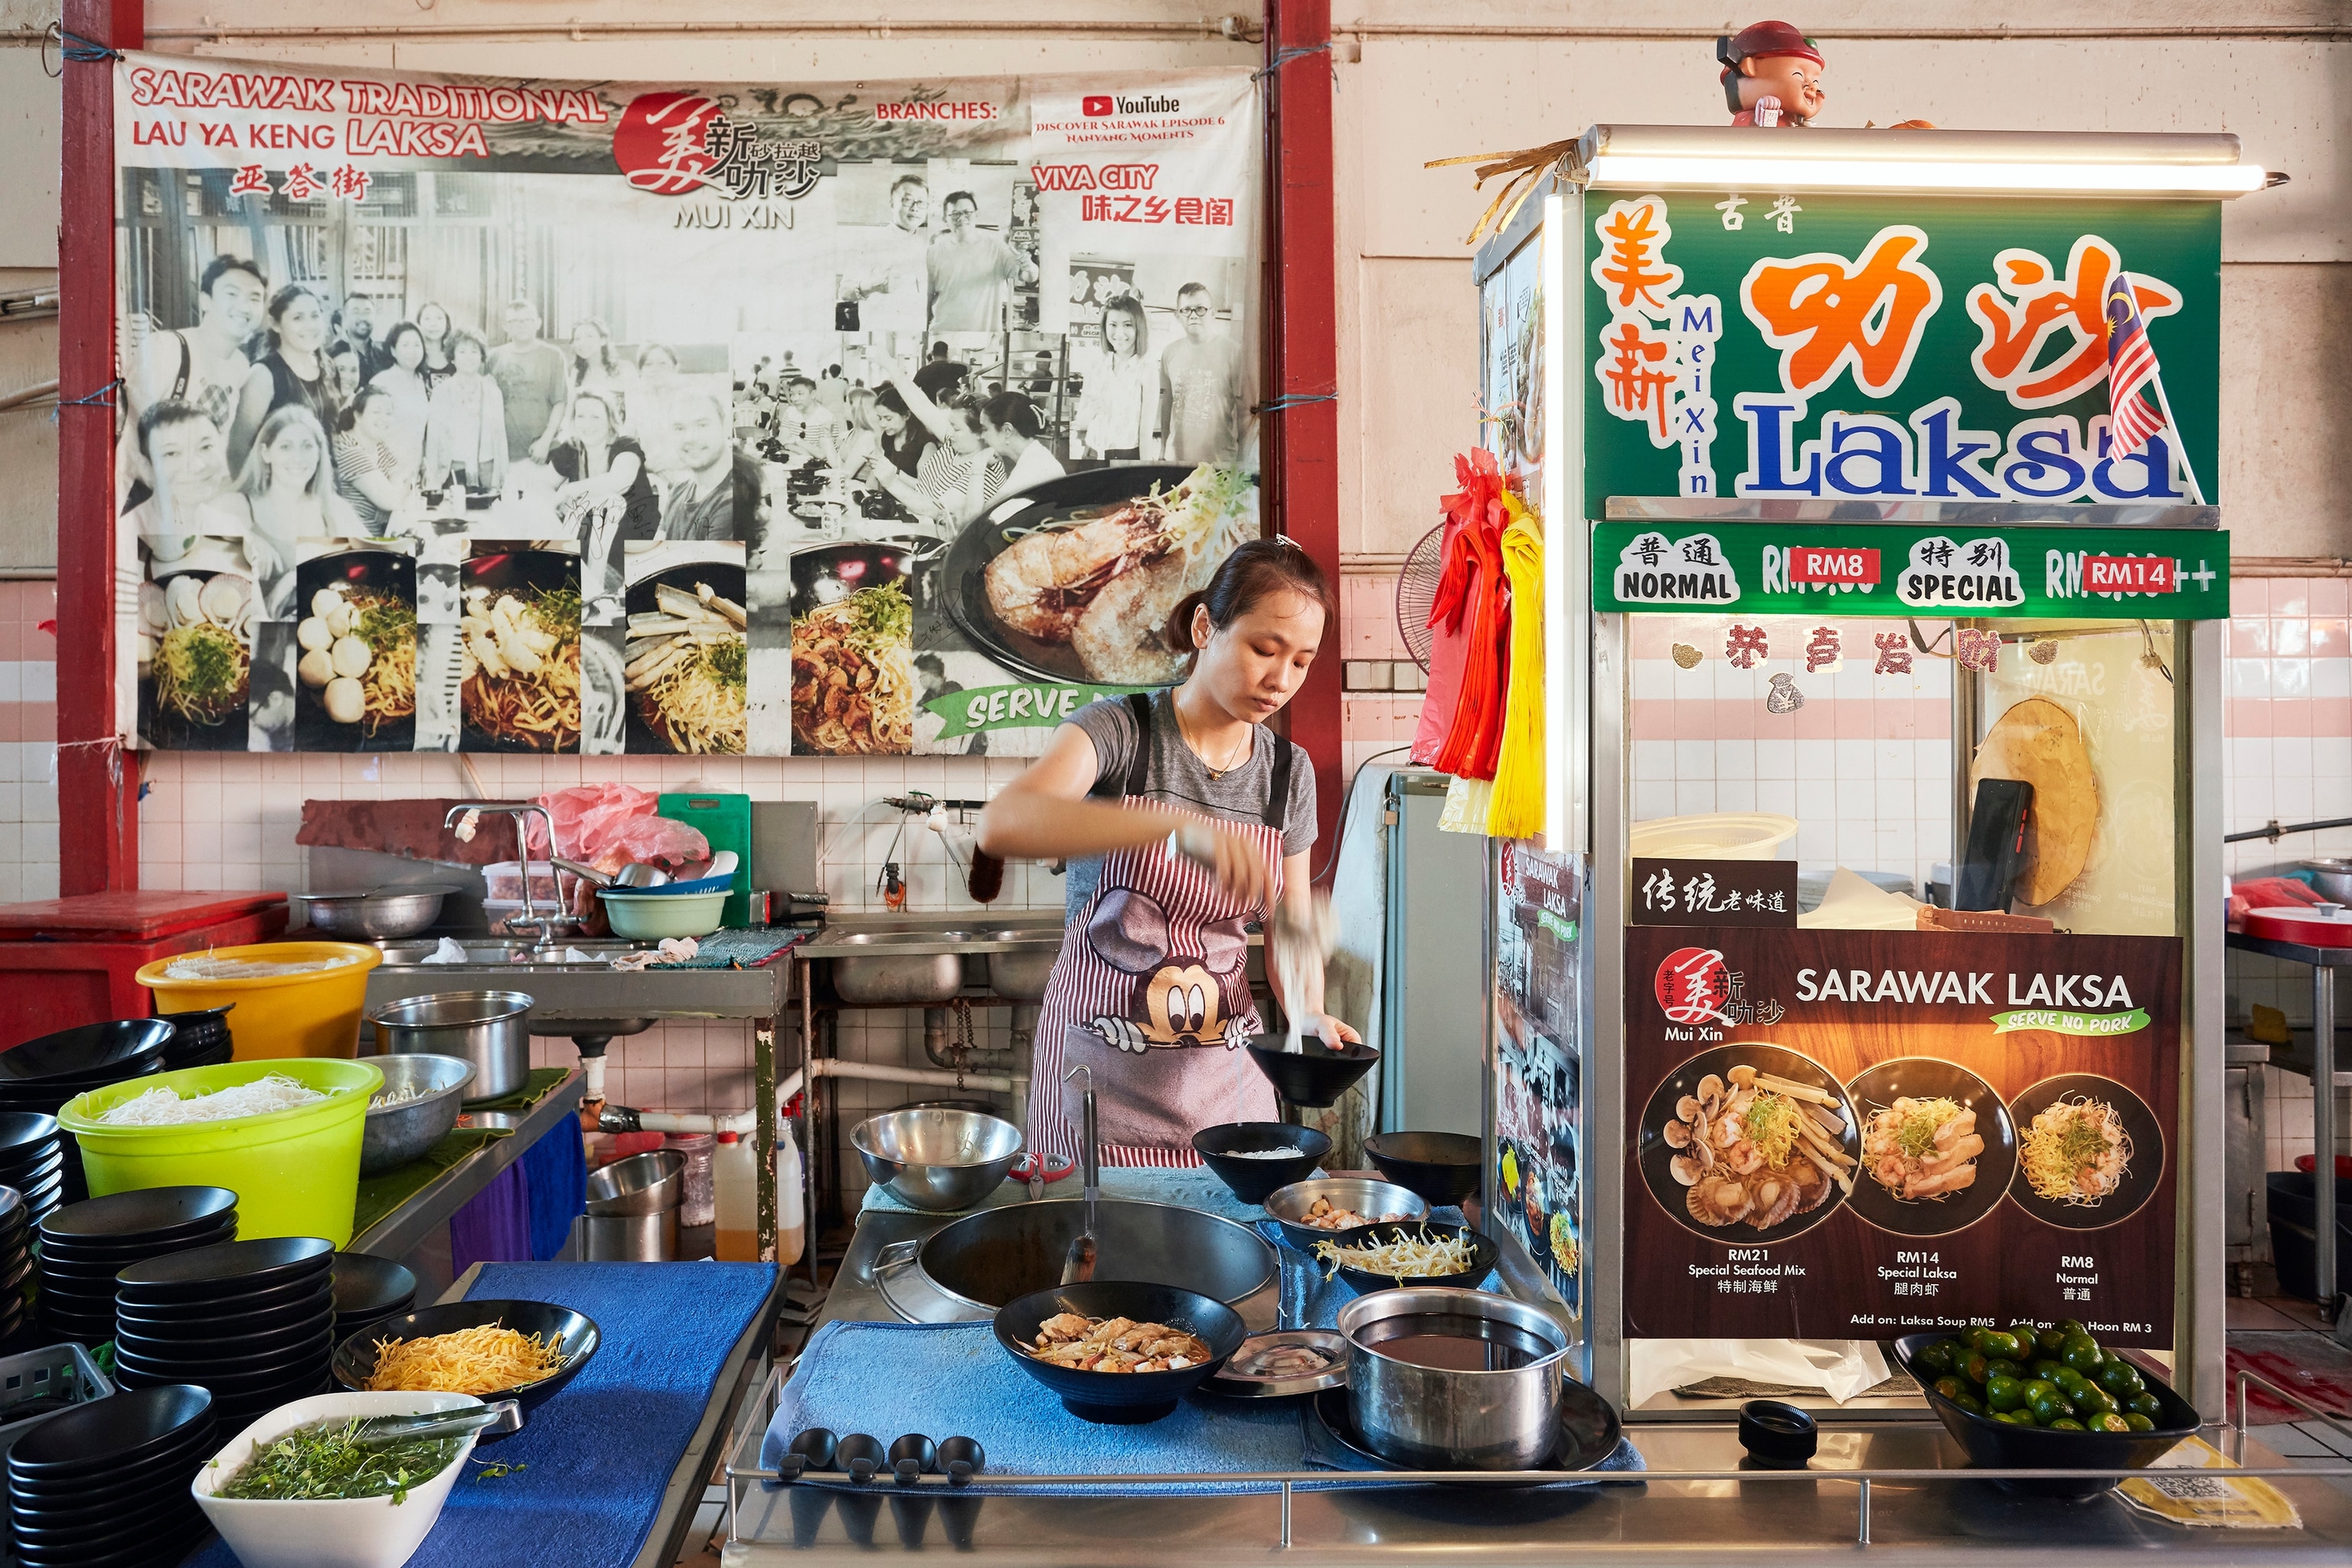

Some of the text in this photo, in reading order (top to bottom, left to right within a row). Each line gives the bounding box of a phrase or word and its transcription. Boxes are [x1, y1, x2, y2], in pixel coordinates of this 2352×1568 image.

[130, 67, 609, 123] SARAWAK TRADITIONAL
[1116, 96, 1180, 114] YouTube
[875, 101, 998, 121] BRANCHES:
[1218, 116, 1225, 126] 6
[132, 119, 490, 158] LAU YA KENG LAKSA
[230, 163, 372, 202] 亚答街
[1031, 164, 1159, 191] VIVA CITY
[675, 203, 794, 230] MUI XIN
[1082, 194, 1233, 226] 味之乡食阁
[1743, 404, 2184, 499] Laksa
[1630, 536, 1720, 567] 普通
[1920, 540, 2002, 570] 特别
[1808, 554, 1864, 577] RM8
[2092, 562, 2166, 585] RM14
[1622, 572, 1732, 599] NORMAL
[1906, 573, 2018, 603] SPECIAL
[965, 688, 1080, 728] SERVE
[1525, 856, 1559, 890] SARAWAK
[1544, 887, 1567, 918] LAKSA
[1663, 969, 1675, 1007] 老字号
[1795, 968, 2134, 1008] SARAWAK LAKSA
[2007, 1011, 2133, 1033] SERVE NO PORK
[1664, 1027, 1723, 1041] Mui Xin
[1728, 1249, 1769, 1261] RM21
[1896, 1251, 1939, 1264] RM14
[2061, 1256, 2094, 1269] RM8
[1688, 1263, 1807, 1279] Special Seafood Mix
[1877, 1266, 1958, 1280] Special Laksa
[2056, 1272, 2099, 1285] Normal
[1717, 1279, 1778, 1294] 特制海鲜
[1893, 1282, 1939, 1296] 腿肉虾
[2062, 1287, 2092, 1301] 普通
[1851, 1314, 1995, 1329] Add on: Laksa Soup RM5
[2088, 1321, 2119, 1332] Hoon
[2123, 1322, 2141, 1333] RM
[2144, 1324, 2152, 1333] 3
